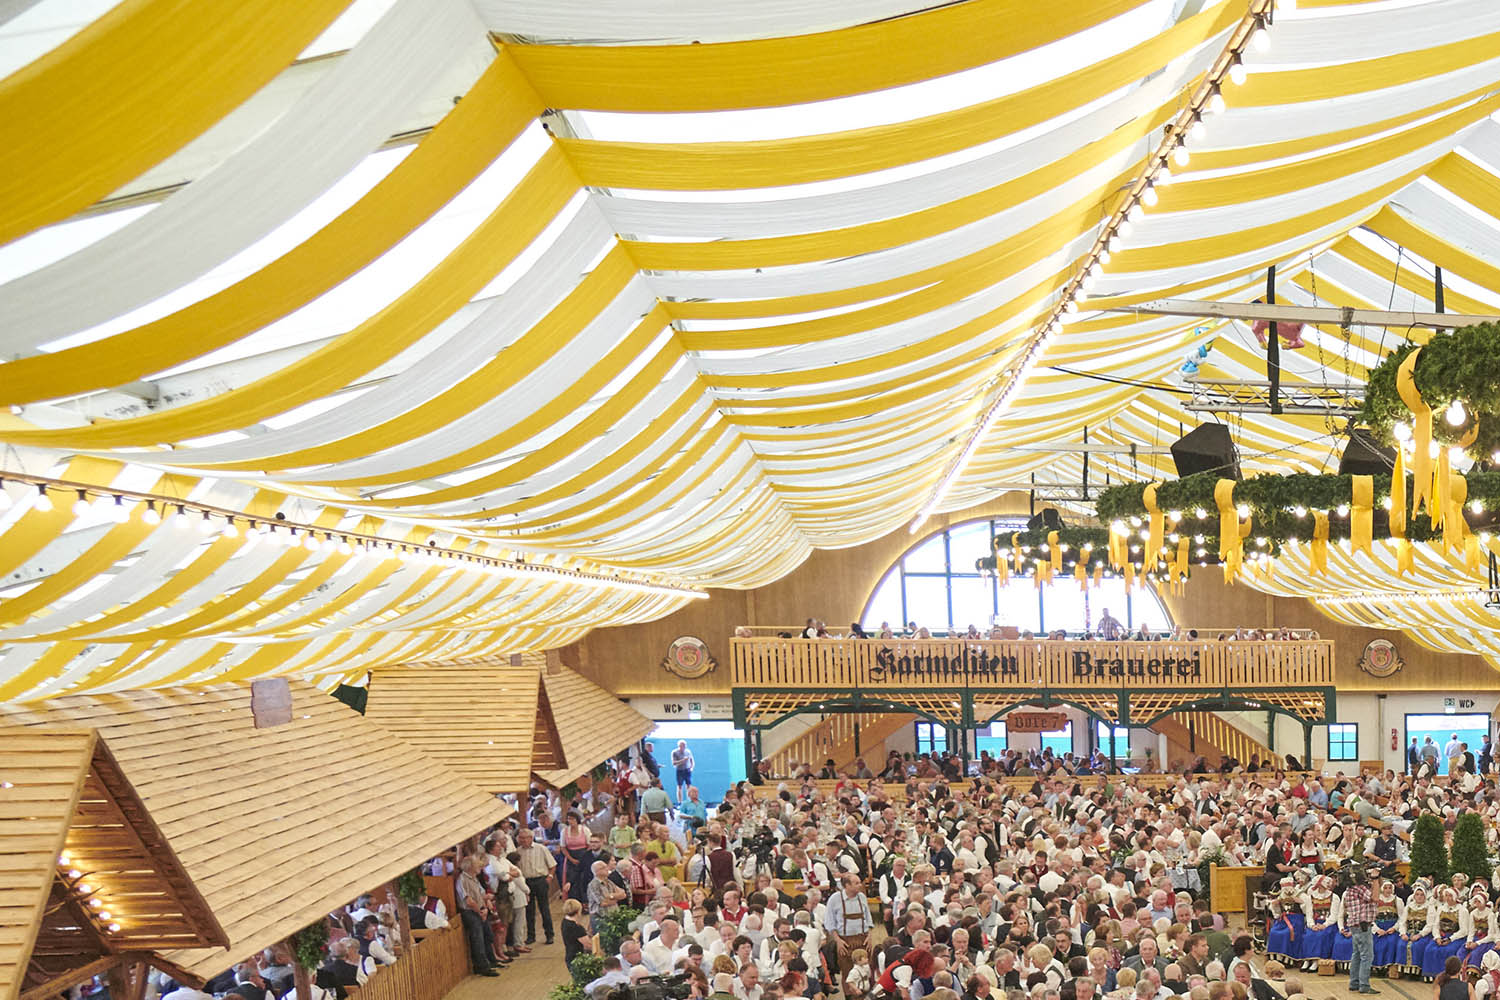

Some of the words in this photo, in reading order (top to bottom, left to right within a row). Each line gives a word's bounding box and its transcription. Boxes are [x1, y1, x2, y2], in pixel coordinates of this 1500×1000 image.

[870, 644, 1018, 682] Karmeliten
[1072, 650, 1202, 677] Brauerei
[663, 704, 677, 713] WC
[1459, 700, 1471, 708] WC
